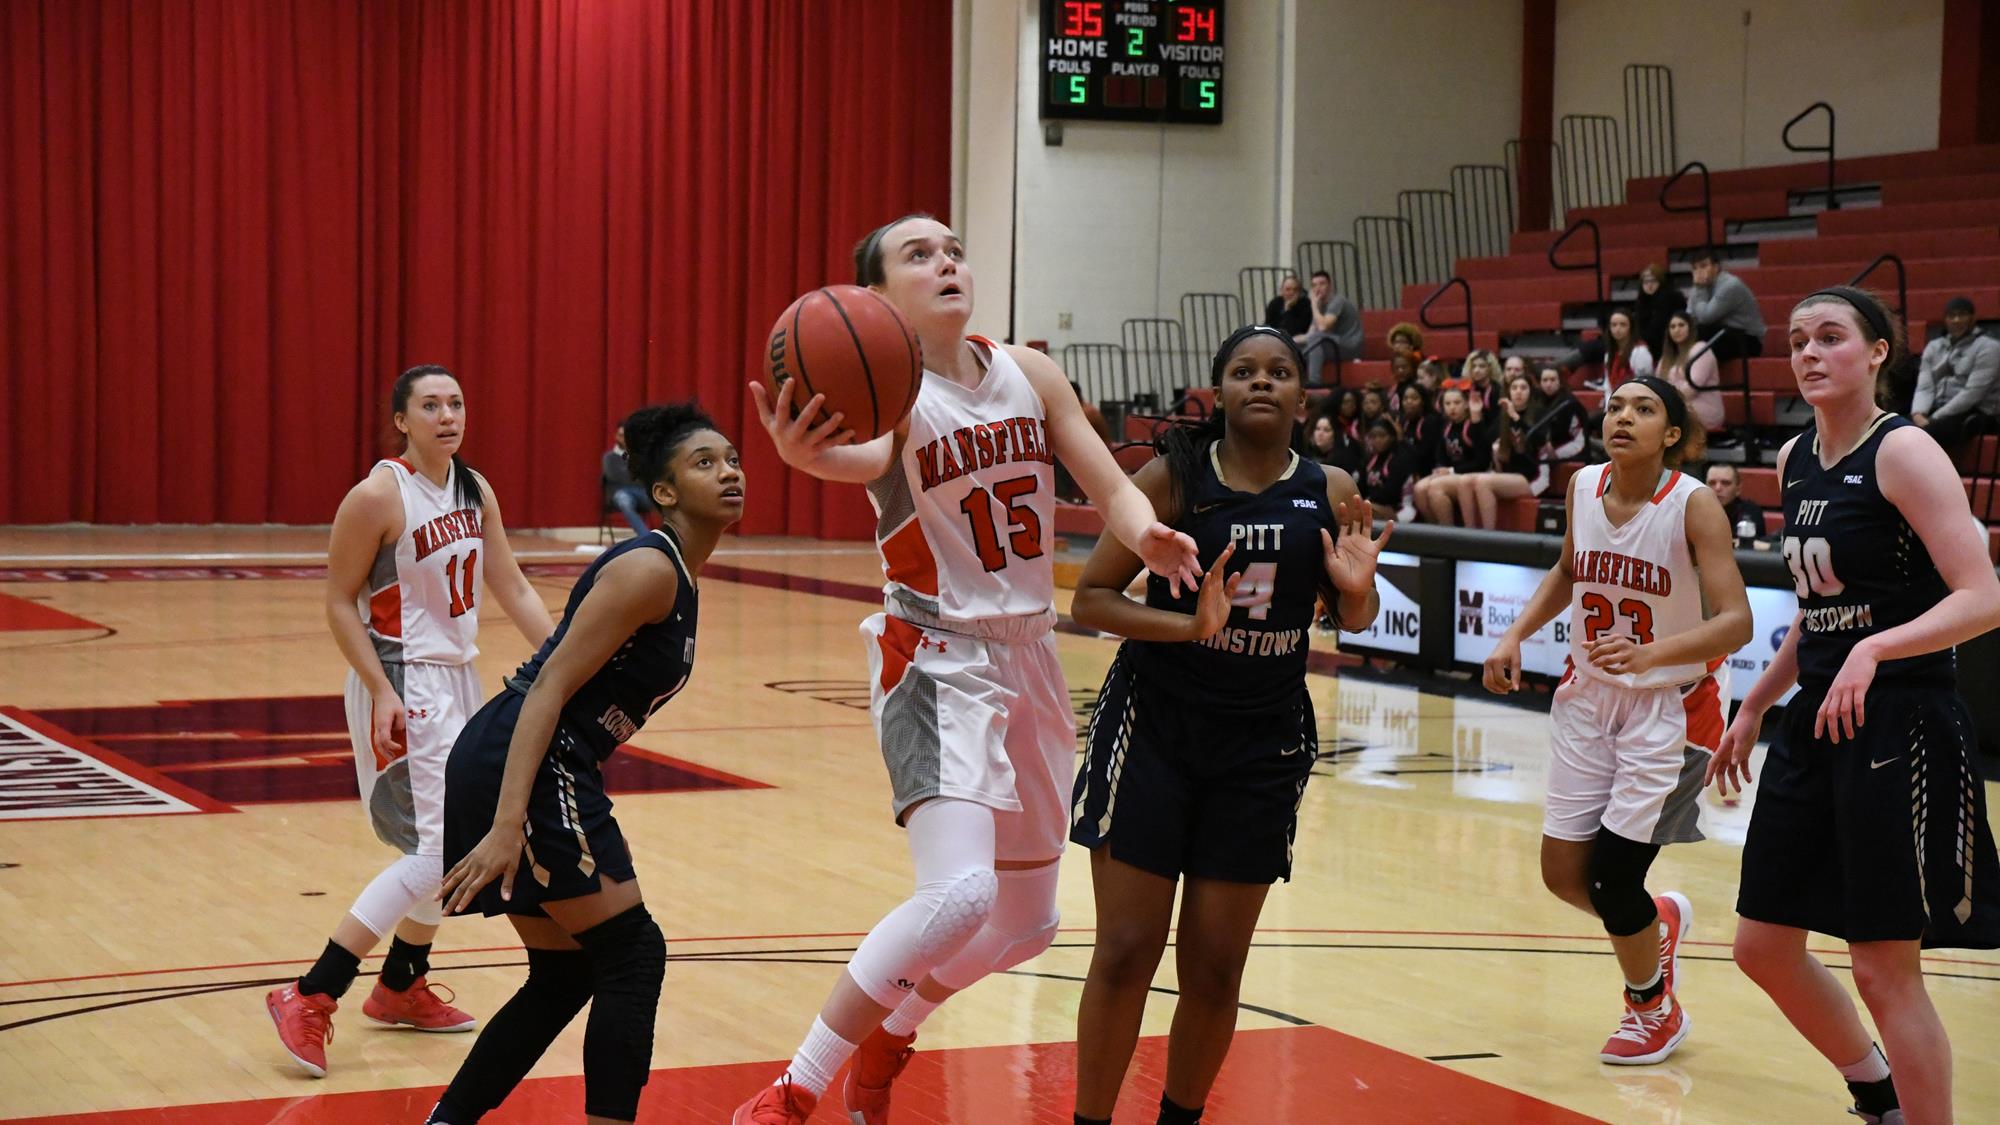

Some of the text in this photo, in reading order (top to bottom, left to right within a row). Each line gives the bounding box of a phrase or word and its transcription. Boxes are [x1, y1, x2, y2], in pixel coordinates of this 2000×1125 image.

[1065, 2, 1102, 36] 35
[1115, 14, 1157, 27] PERIOD
[1177, 7, 1215, 41] 34
[1049, 39, 1108, 58] HOME
[1128, 28, 1143, 55] 2
[1159, 44, 1223, 62] VISITOR
[1048, 59, 1091, 74] FOULS
[1111, 62, 1159, 76] PLAYER
[1179, 65, 1220, 79] FOULS
[1070, 76, 1085, 103] 5
[1200, 81, 1215, 108] 5
[1843, 475, 1863, 484] PSAC
[1292, 499, 1317, 509] PSAC
[1795, 500, 1829, 525] PITT
[412, 508, 485, 562] MANSFIEL
[960, 474, 1044, 573] 15
[1231, 524, 1284, 550] PITT
[1573, 551, 1671, 597] ANSFIELD
[1783, 536, 1845, 599] 30
[446, 548, 477, 618] 11
[1231, 563, 1278, 620] 4
[1385, 609, 1418, 638] INC
[1582, 592, 1654, 645] 23
[1192, 627, 1301, 657] NSTOWN
